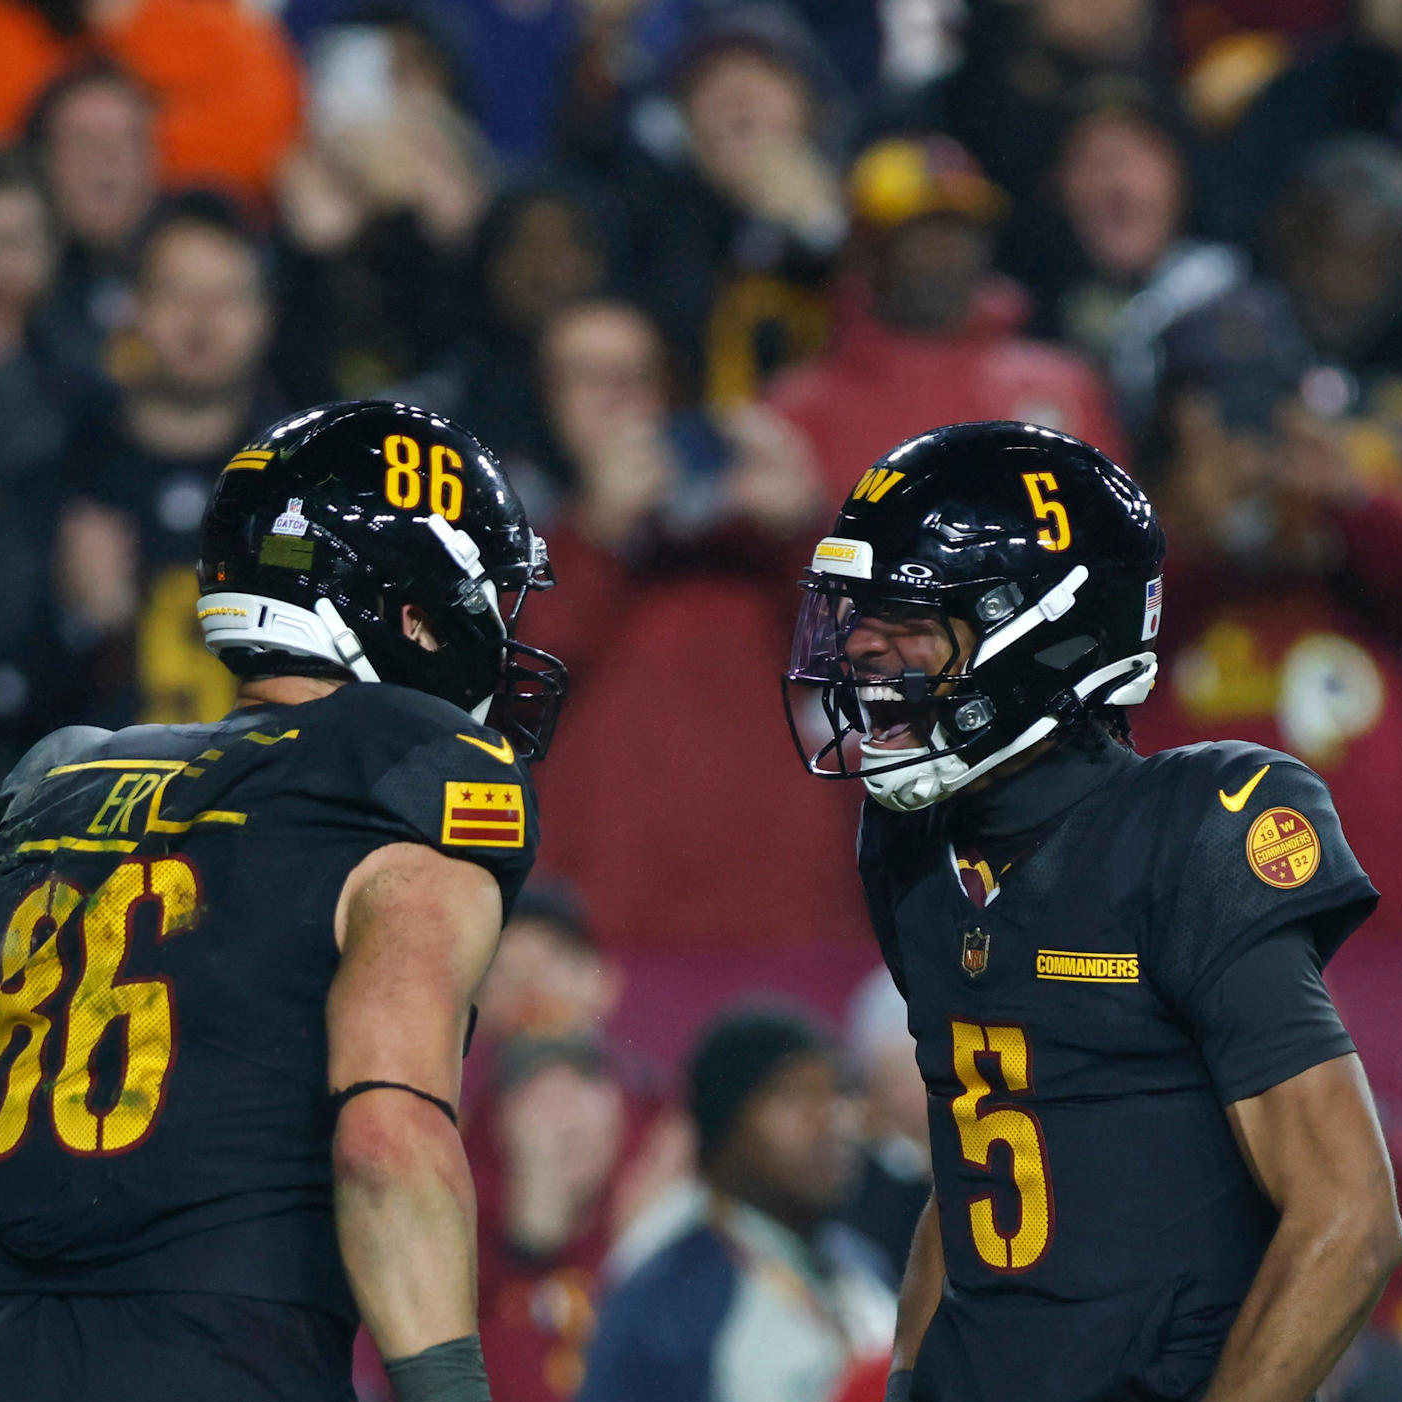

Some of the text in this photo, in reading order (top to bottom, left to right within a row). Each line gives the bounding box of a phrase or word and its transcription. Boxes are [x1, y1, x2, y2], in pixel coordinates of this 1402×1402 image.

[382, 433, 464, 523] 86
[276, 518, 306, 530] CATCH
[1020, 470, 1072, 553] 5
[1260, 819, 1296, 842] 19 W
[1255, 832, 1313, 864] COMMANDERS
[1294, 855, 1309, 868] 32
[1036, 954, 1140, 978] COMMANDERS
[950, 1015, 1056, 1274] 5
